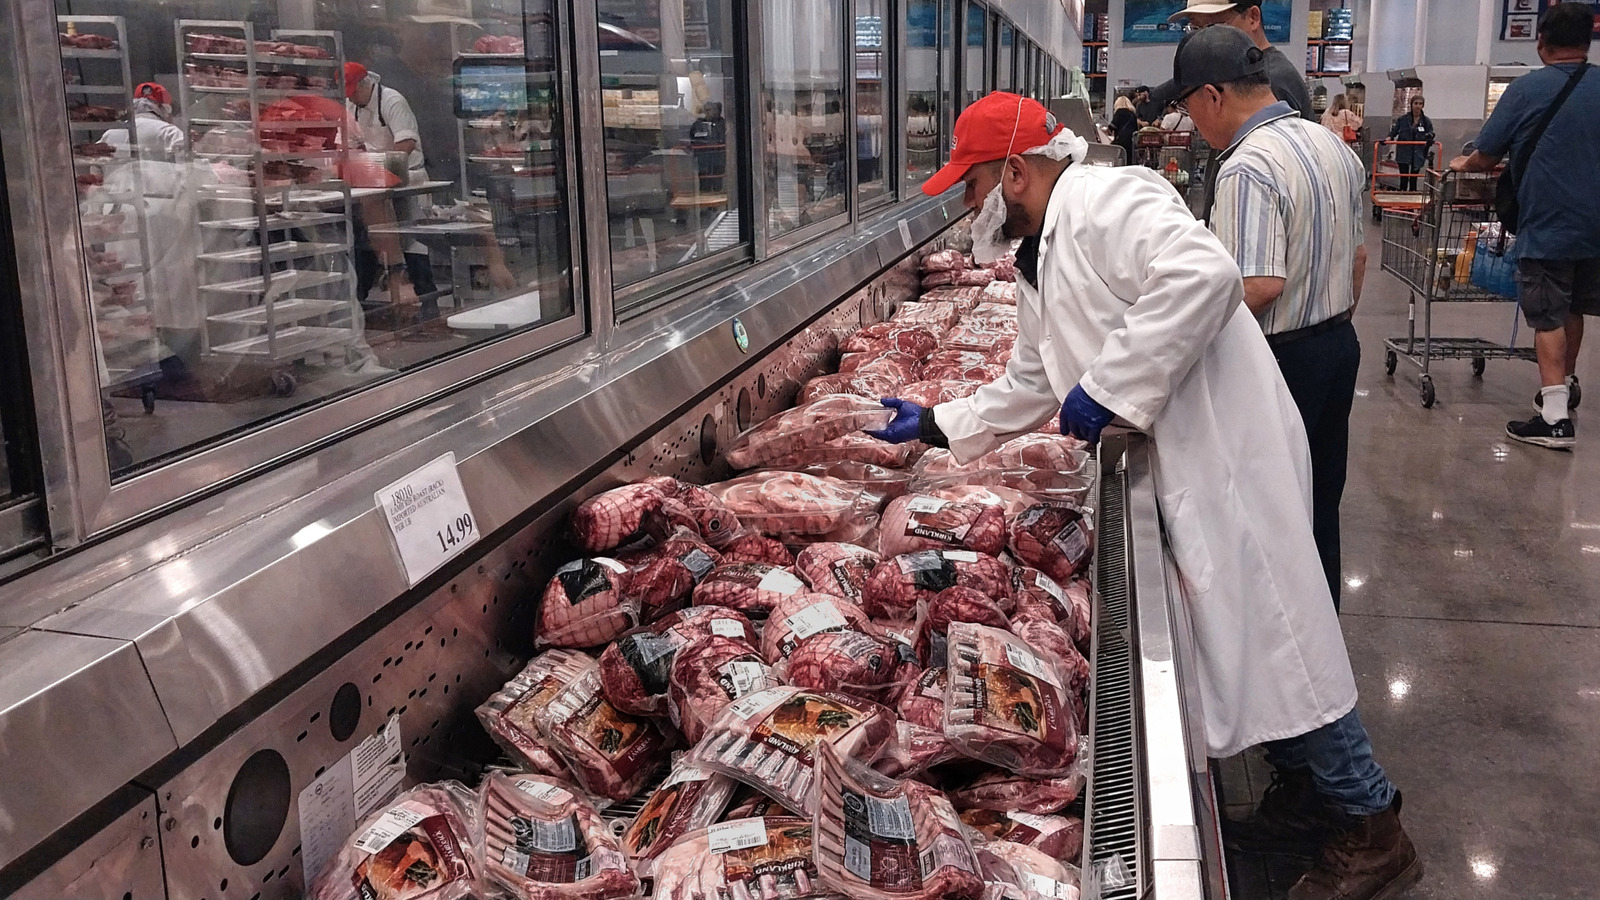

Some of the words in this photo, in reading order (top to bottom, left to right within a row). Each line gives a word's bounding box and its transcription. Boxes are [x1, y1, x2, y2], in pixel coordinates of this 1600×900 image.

[391, 484, 413, 505] 18010
[392, 507, 417, 524] IMPORTED
[417, 488, 446, 509] AUSTRALIAN
[436, 513, 473, 553] 14.99
[914, 527, 952, 541] KIRKLAND
[755, 860, 805, 875] KIRKLAND
